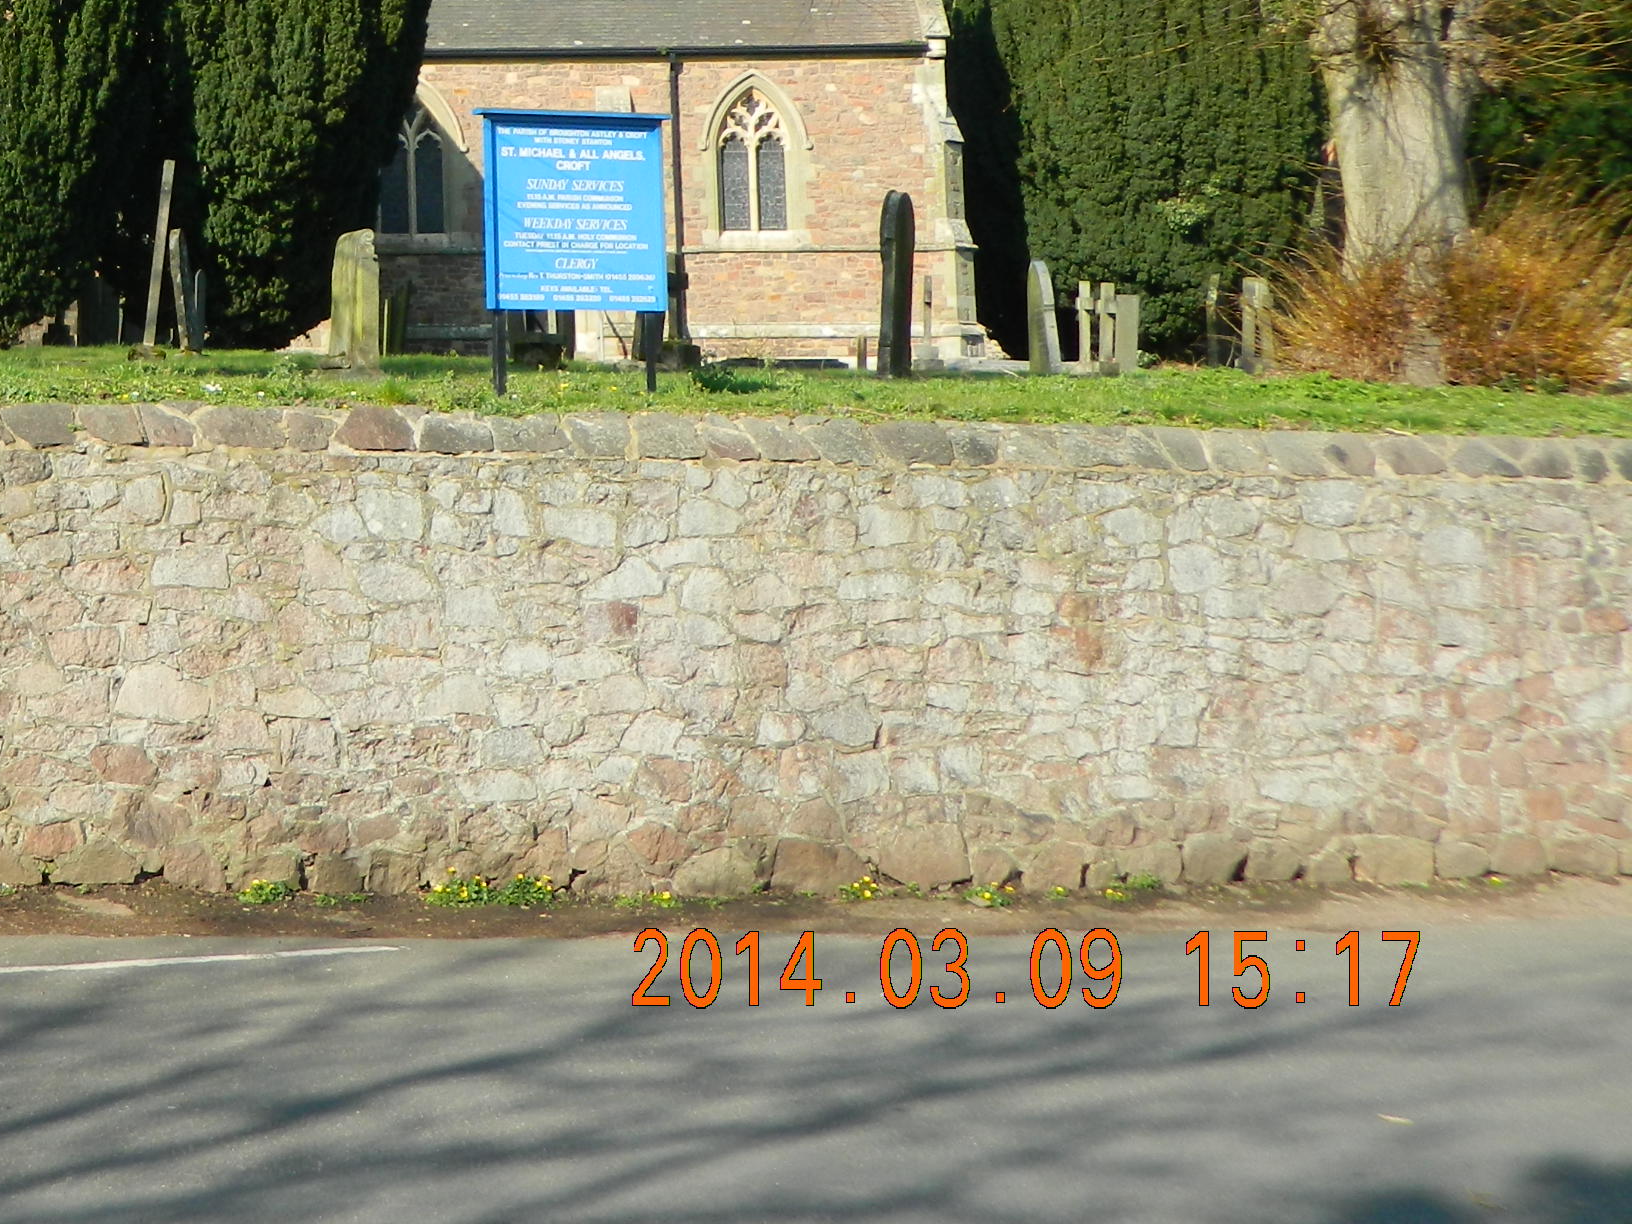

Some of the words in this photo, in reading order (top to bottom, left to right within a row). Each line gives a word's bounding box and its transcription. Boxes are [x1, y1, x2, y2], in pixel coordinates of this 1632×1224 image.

[498, 127, 510, 135] THE
[625, 131, 648, 139] CROFT
[501, 146, 516, 157] ST.
[519, 147, 565, 158] MICHAEL
[569, 149, 576, 158] &
[579, 149, 599, 159] ALL
[556, 160, 592, 170] CROFT
[526, 179, 569, 190] SUNDAY
[572, 179, 624, 192] SERVICES
[524, 217, 573, 229] WEEKDAY
[576, 219, 628, 230] SERVICES
[555, 258, 598, 269] CLERGY
